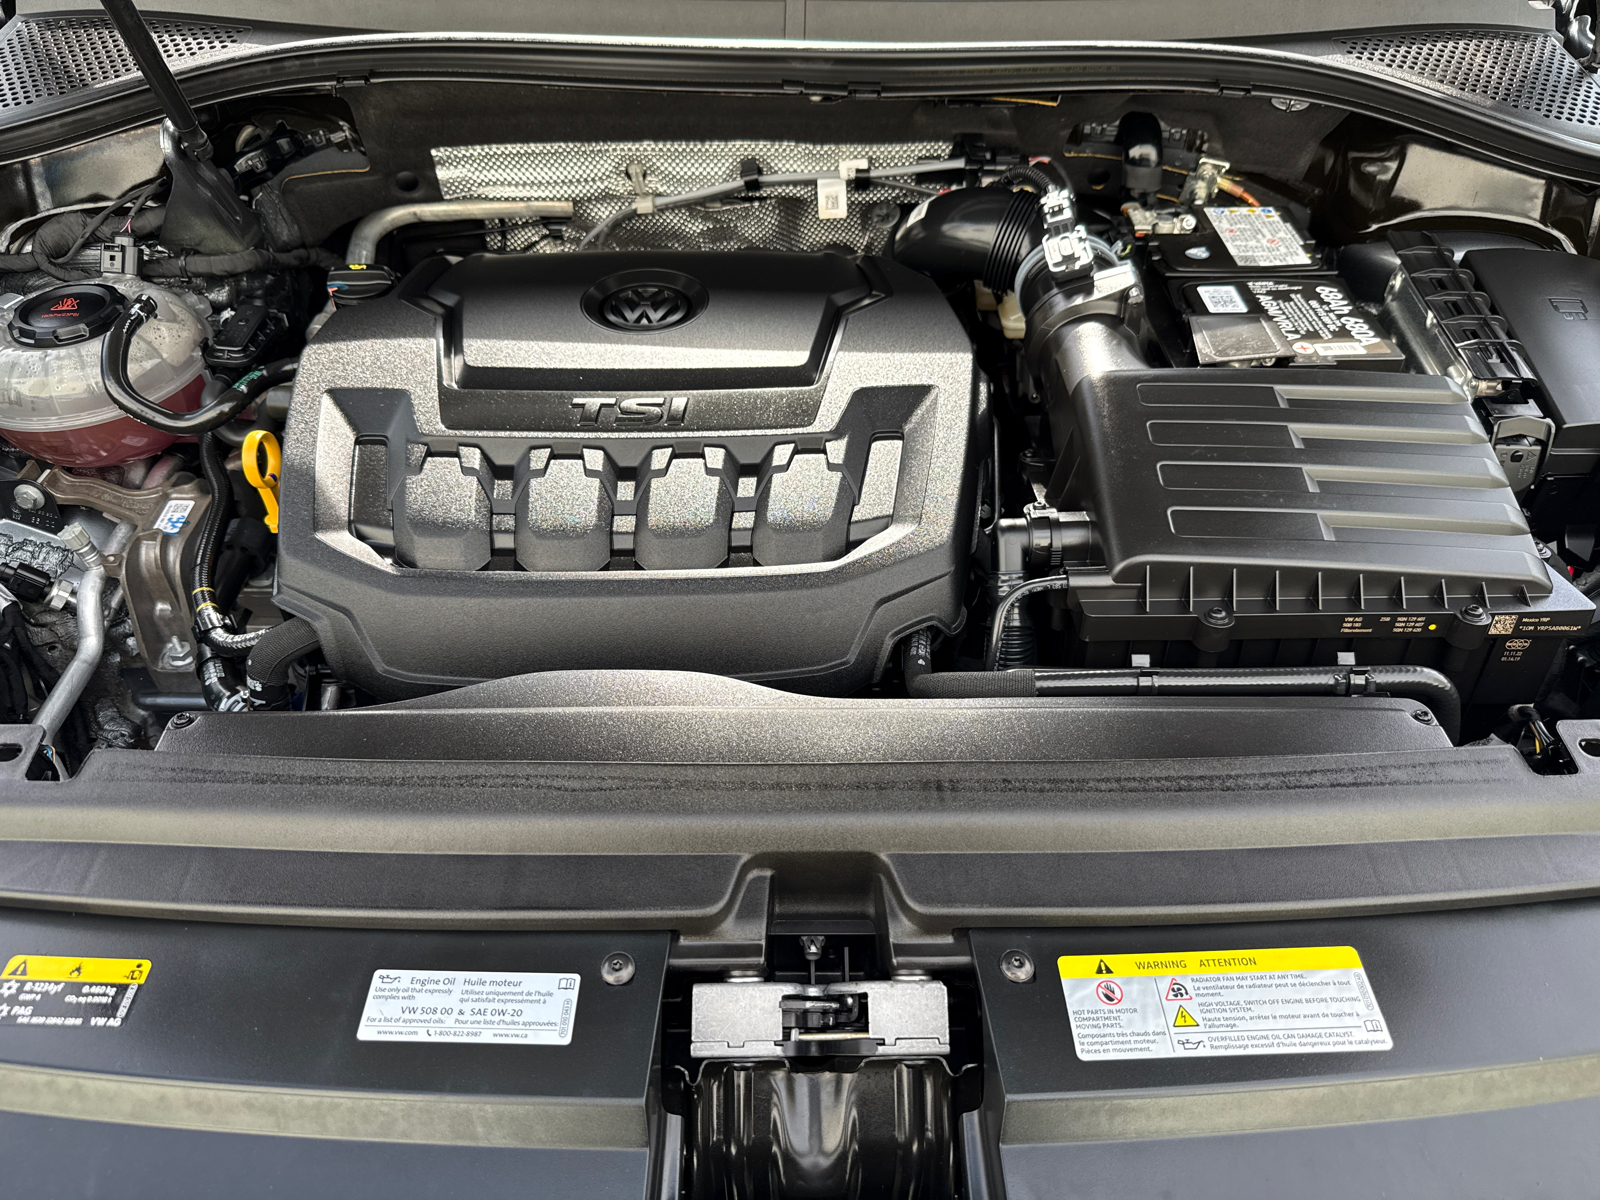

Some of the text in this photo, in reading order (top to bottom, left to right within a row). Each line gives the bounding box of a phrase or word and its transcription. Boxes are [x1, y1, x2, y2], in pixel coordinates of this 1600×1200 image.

[1316, 286, 1353, 314] 68Ah
[1340, 317, 1381, 346] 680A
[569, 397, 689, 426] TSI
[1135, 957, 1257, 970] WARNING ATTENTION
[410, 977, 440, 987] Engine
[463, 978, 487, 986] Huile
[11, 1006, 34, 1016] PAG
[401, 1006, 418, 1014] VW
[420, 1007, 438, 1015] 508
[440, 1007, 453, 1015] 00
[470, 1008, 488, 1016] SAE
[490, 1009, 523, 1017] 0W-20
[90, 1017, 122, 1027] VW AG
[1078, 1032, 1115, 1040] Composants
